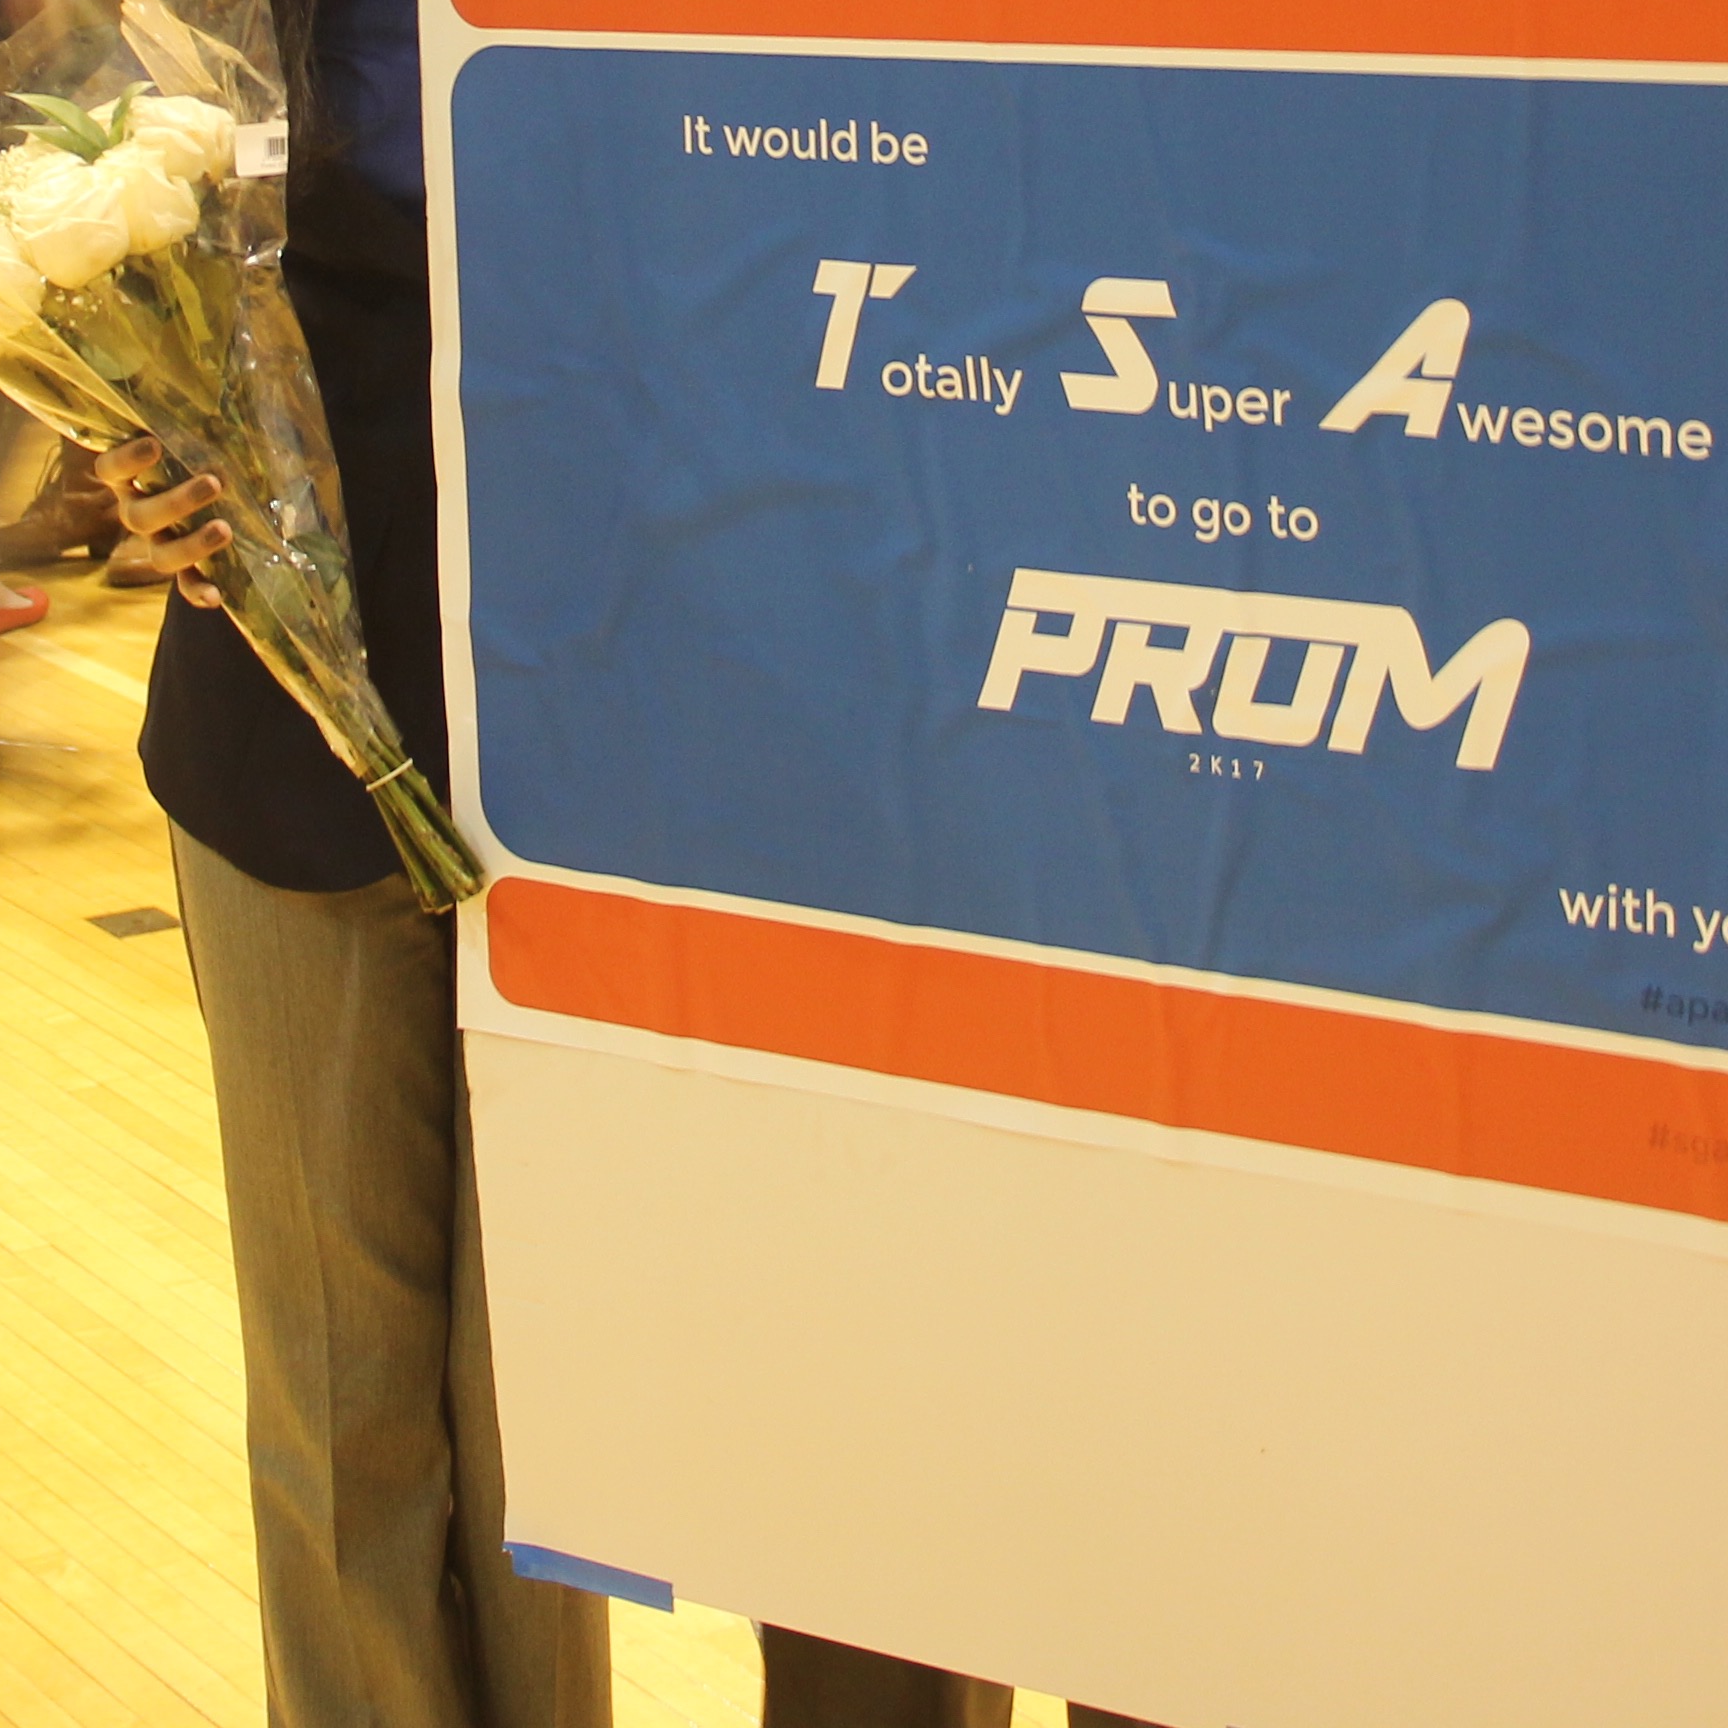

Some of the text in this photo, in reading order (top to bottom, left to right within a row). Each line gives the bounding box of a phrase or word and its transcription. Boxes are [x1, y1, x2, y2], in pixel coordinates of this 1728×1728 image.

[683, 114, 929, 166] It would be
[811, 258, 1714, 461] Totally Super Awesome
[1127, 482, 1320, 544] to go to
[976, 566, 1531, 771] PROM
[1187, 752, 1265, 781] 2K17
[1558, 882, 1676, 940] with
